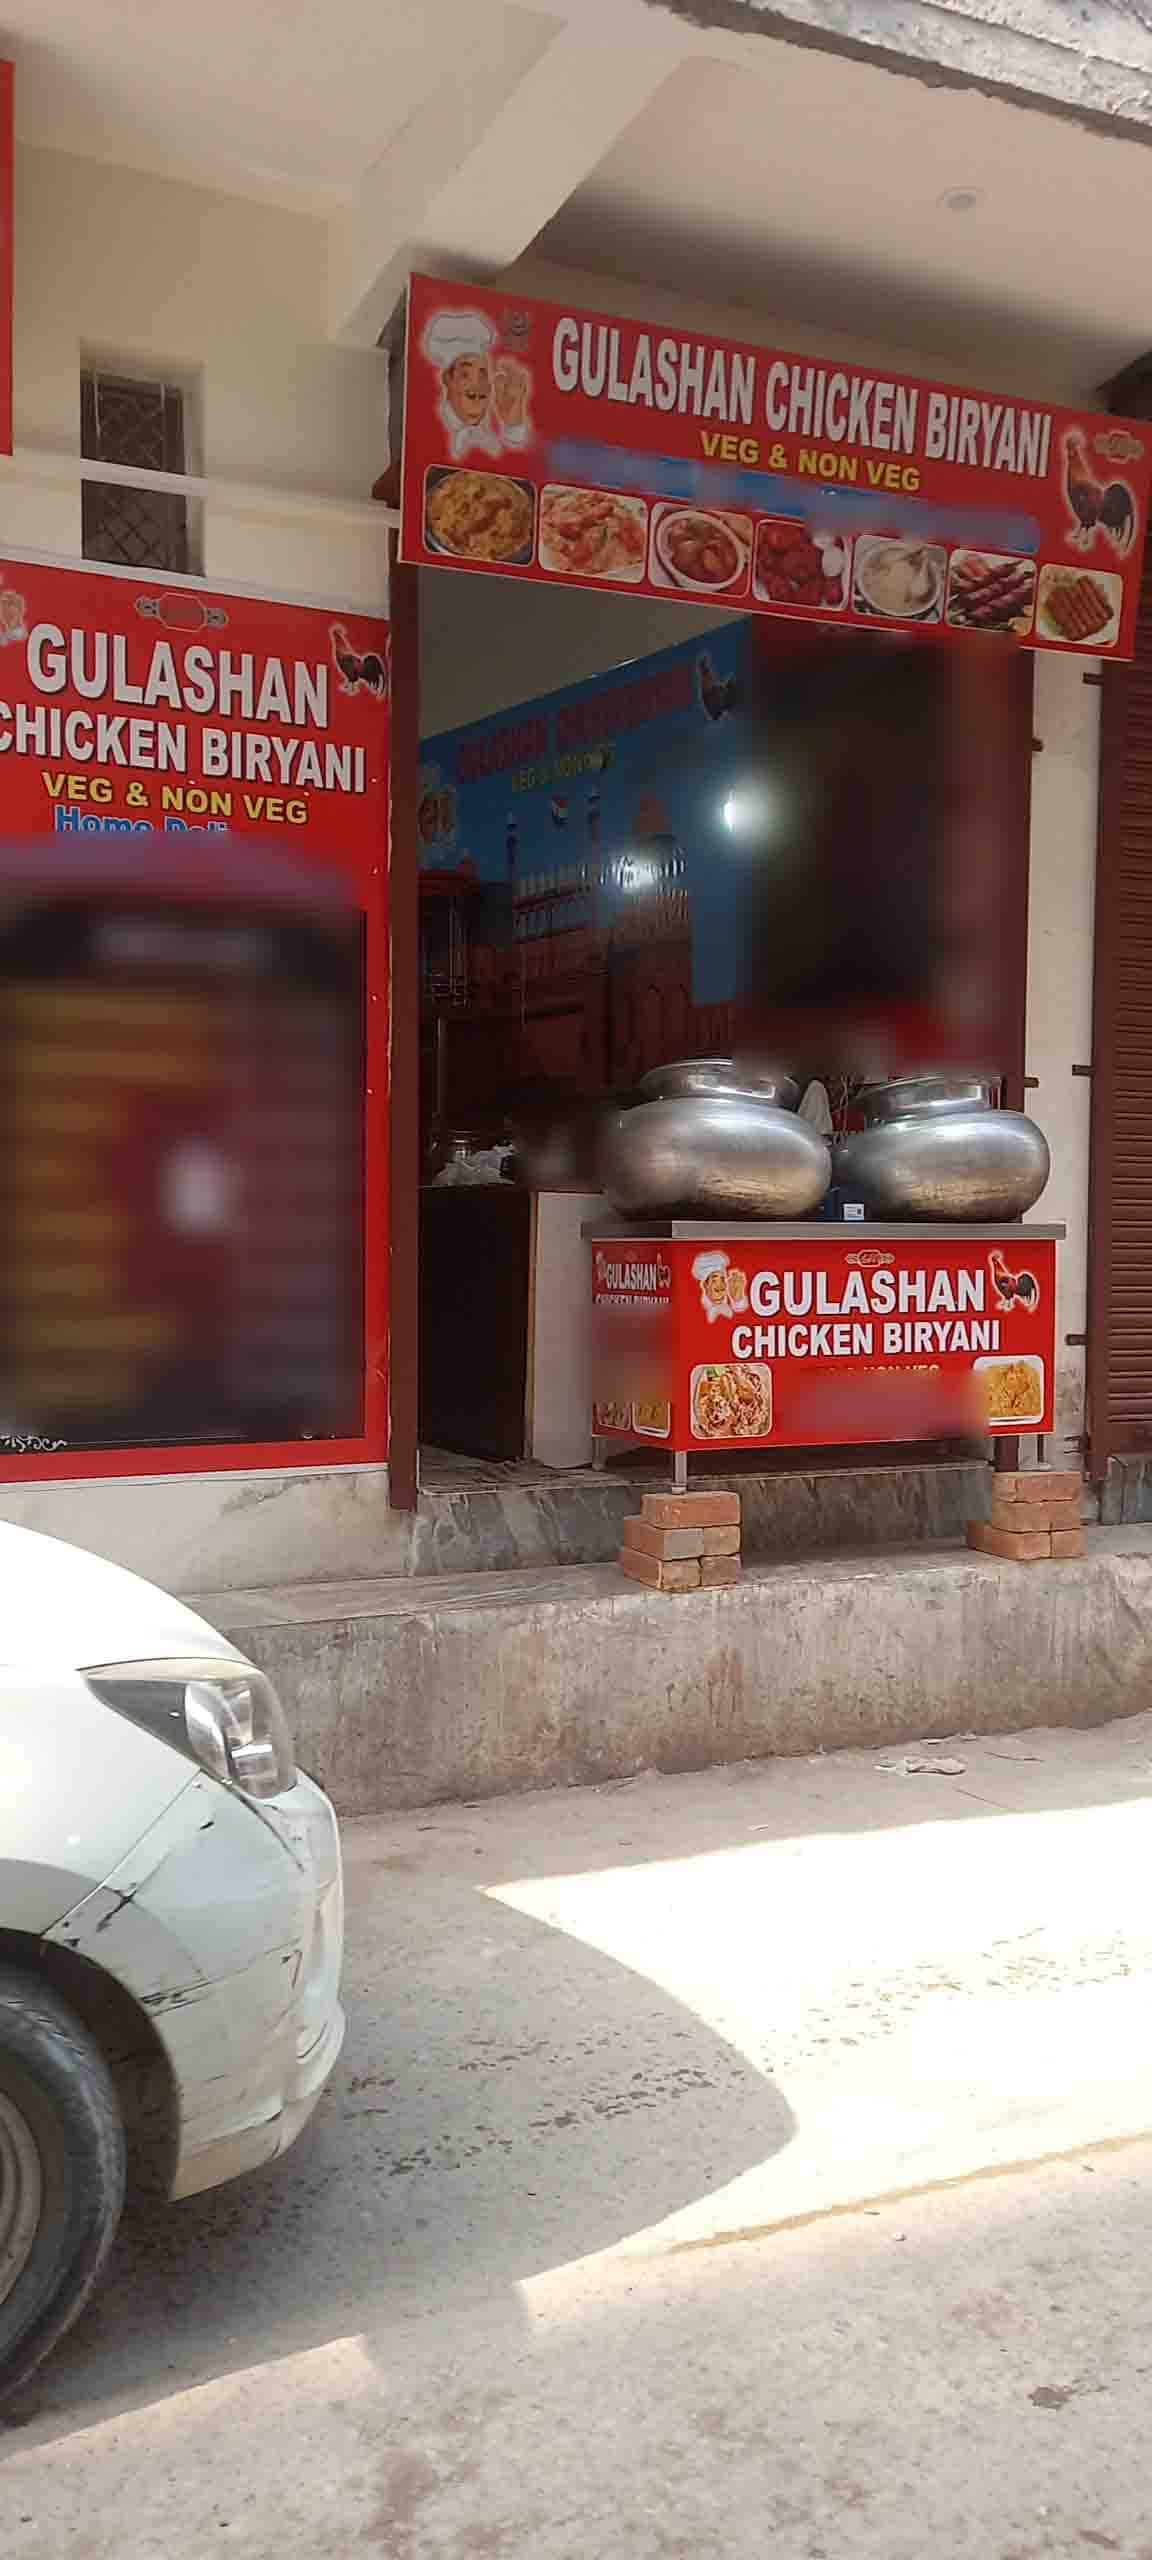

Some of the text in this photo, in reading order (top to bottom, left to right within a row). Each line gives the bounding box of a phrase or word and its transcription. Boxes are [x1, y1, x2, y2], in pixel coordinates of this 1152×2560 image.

[552, 316, 1051, 479] GULASHAN CHICKEN BIRYANI
[700, 430, 921, 492] VEG & NON VEG
[26, 622, 329, 729] GULASHAN
[201, 726, 367, 794] BIRYANI
[41, 771, 114, 804] VEG
[125, 781, 150, 808] &
[161, 785, 233, 817] NON
[242, 793, 309, 825] VEG
[606, 1263, 657, 1291] GULASHAN
[751, 1269, 986, 1318] GULASHAN
[731, 1319, 1000, 1360] CHICKEN BIRYANI
